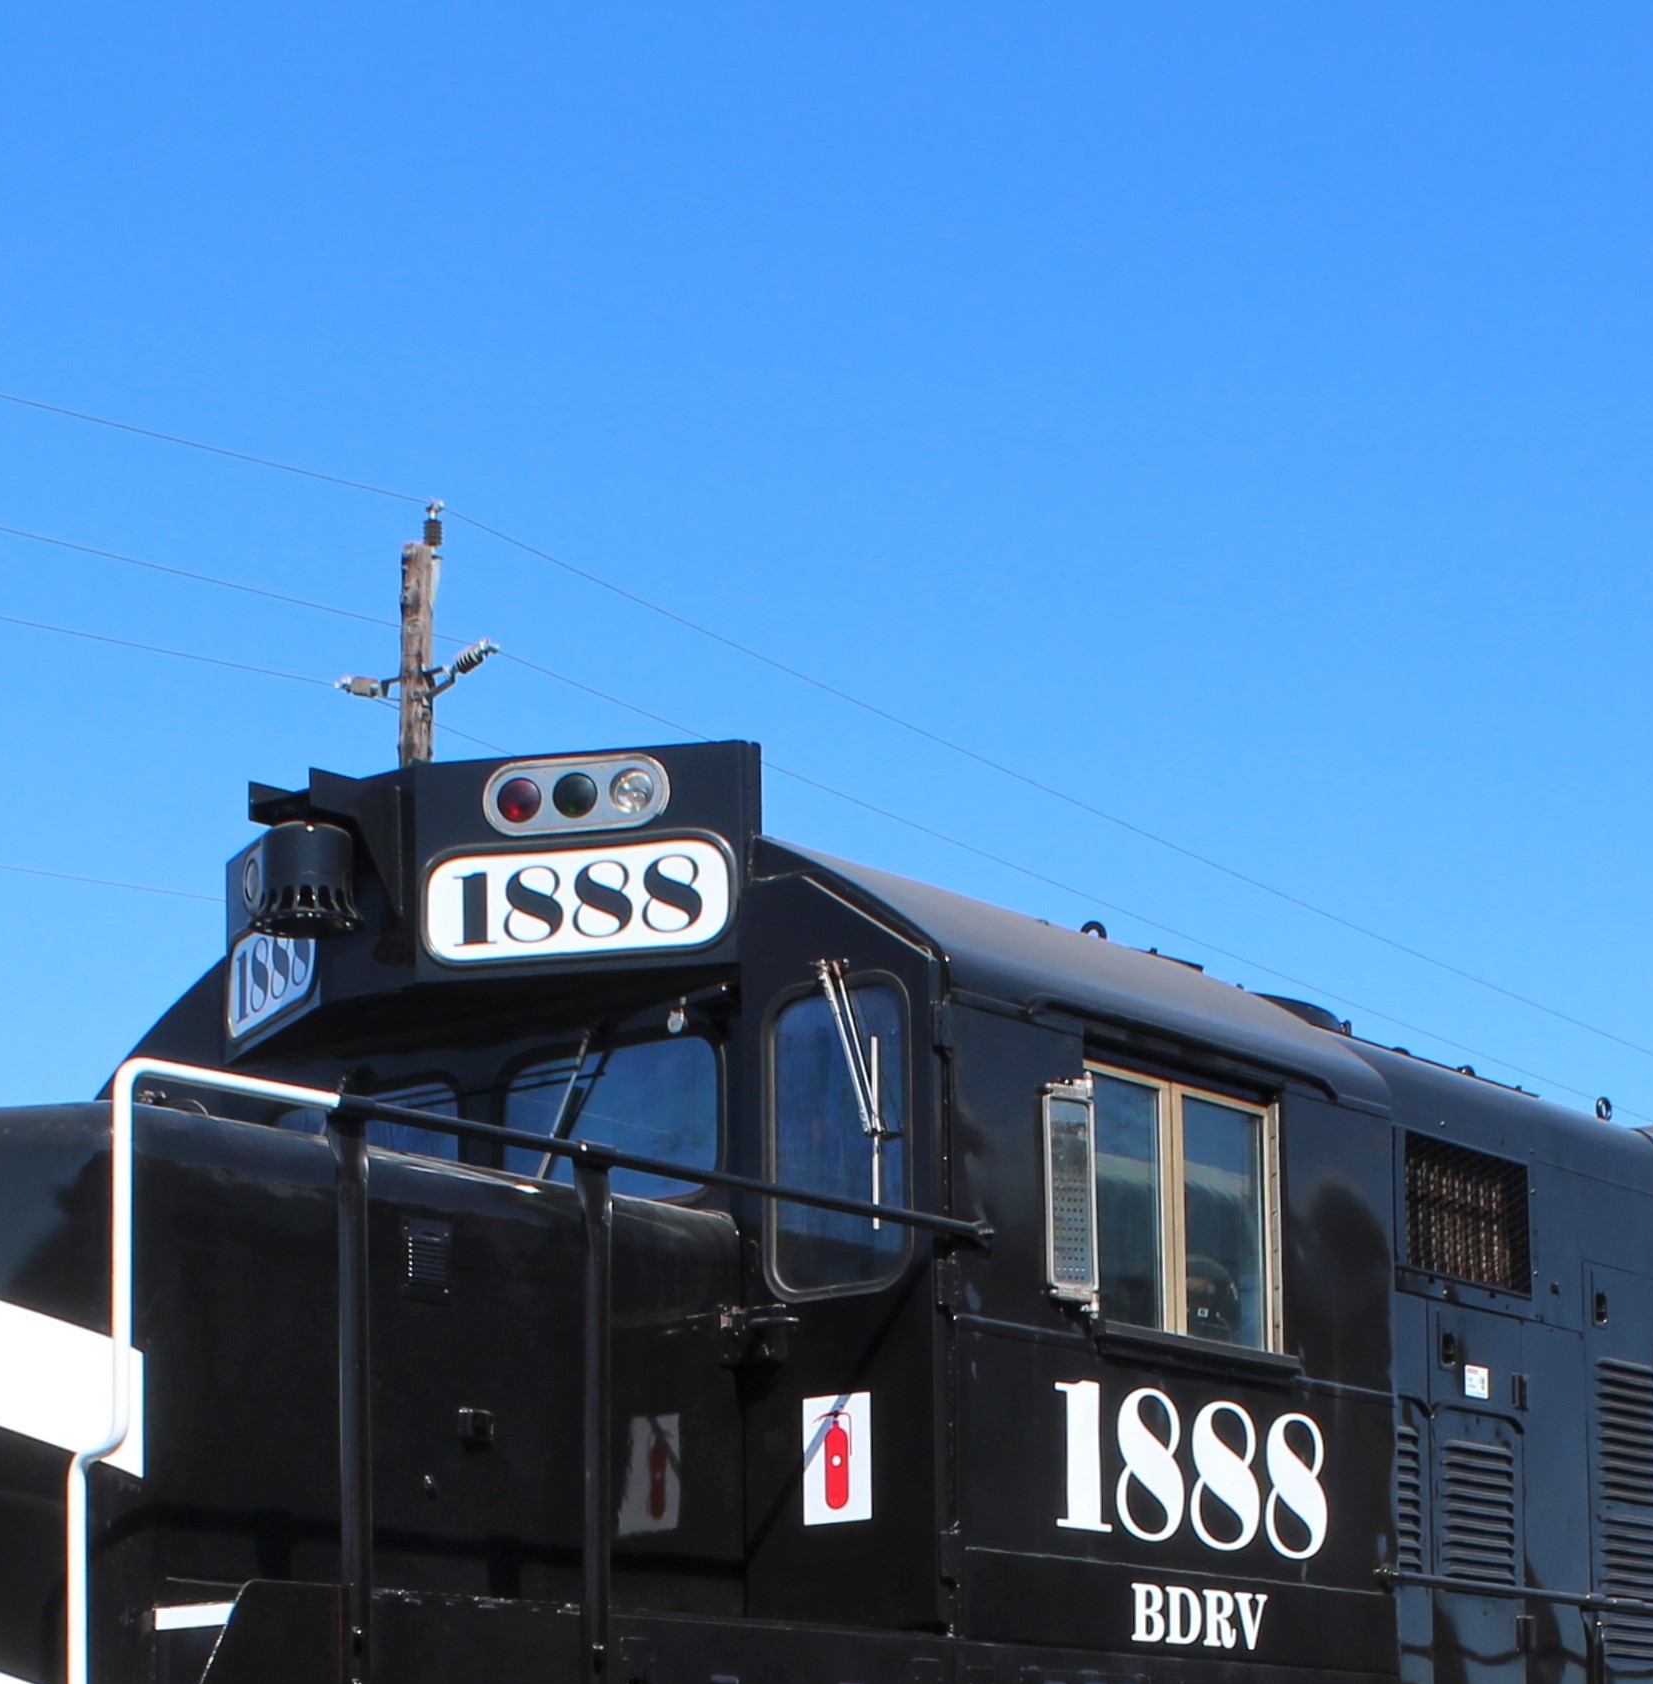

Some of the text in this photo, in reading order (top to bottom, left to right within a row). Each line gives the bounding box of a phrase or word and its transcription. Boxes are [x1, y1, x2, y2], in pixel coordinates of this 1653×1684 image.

[453, 854, 703, 947] 1888
[1055, 1379, 1328, 1560] 1888
[1131, 1582, 1268, 1650] BDRV
